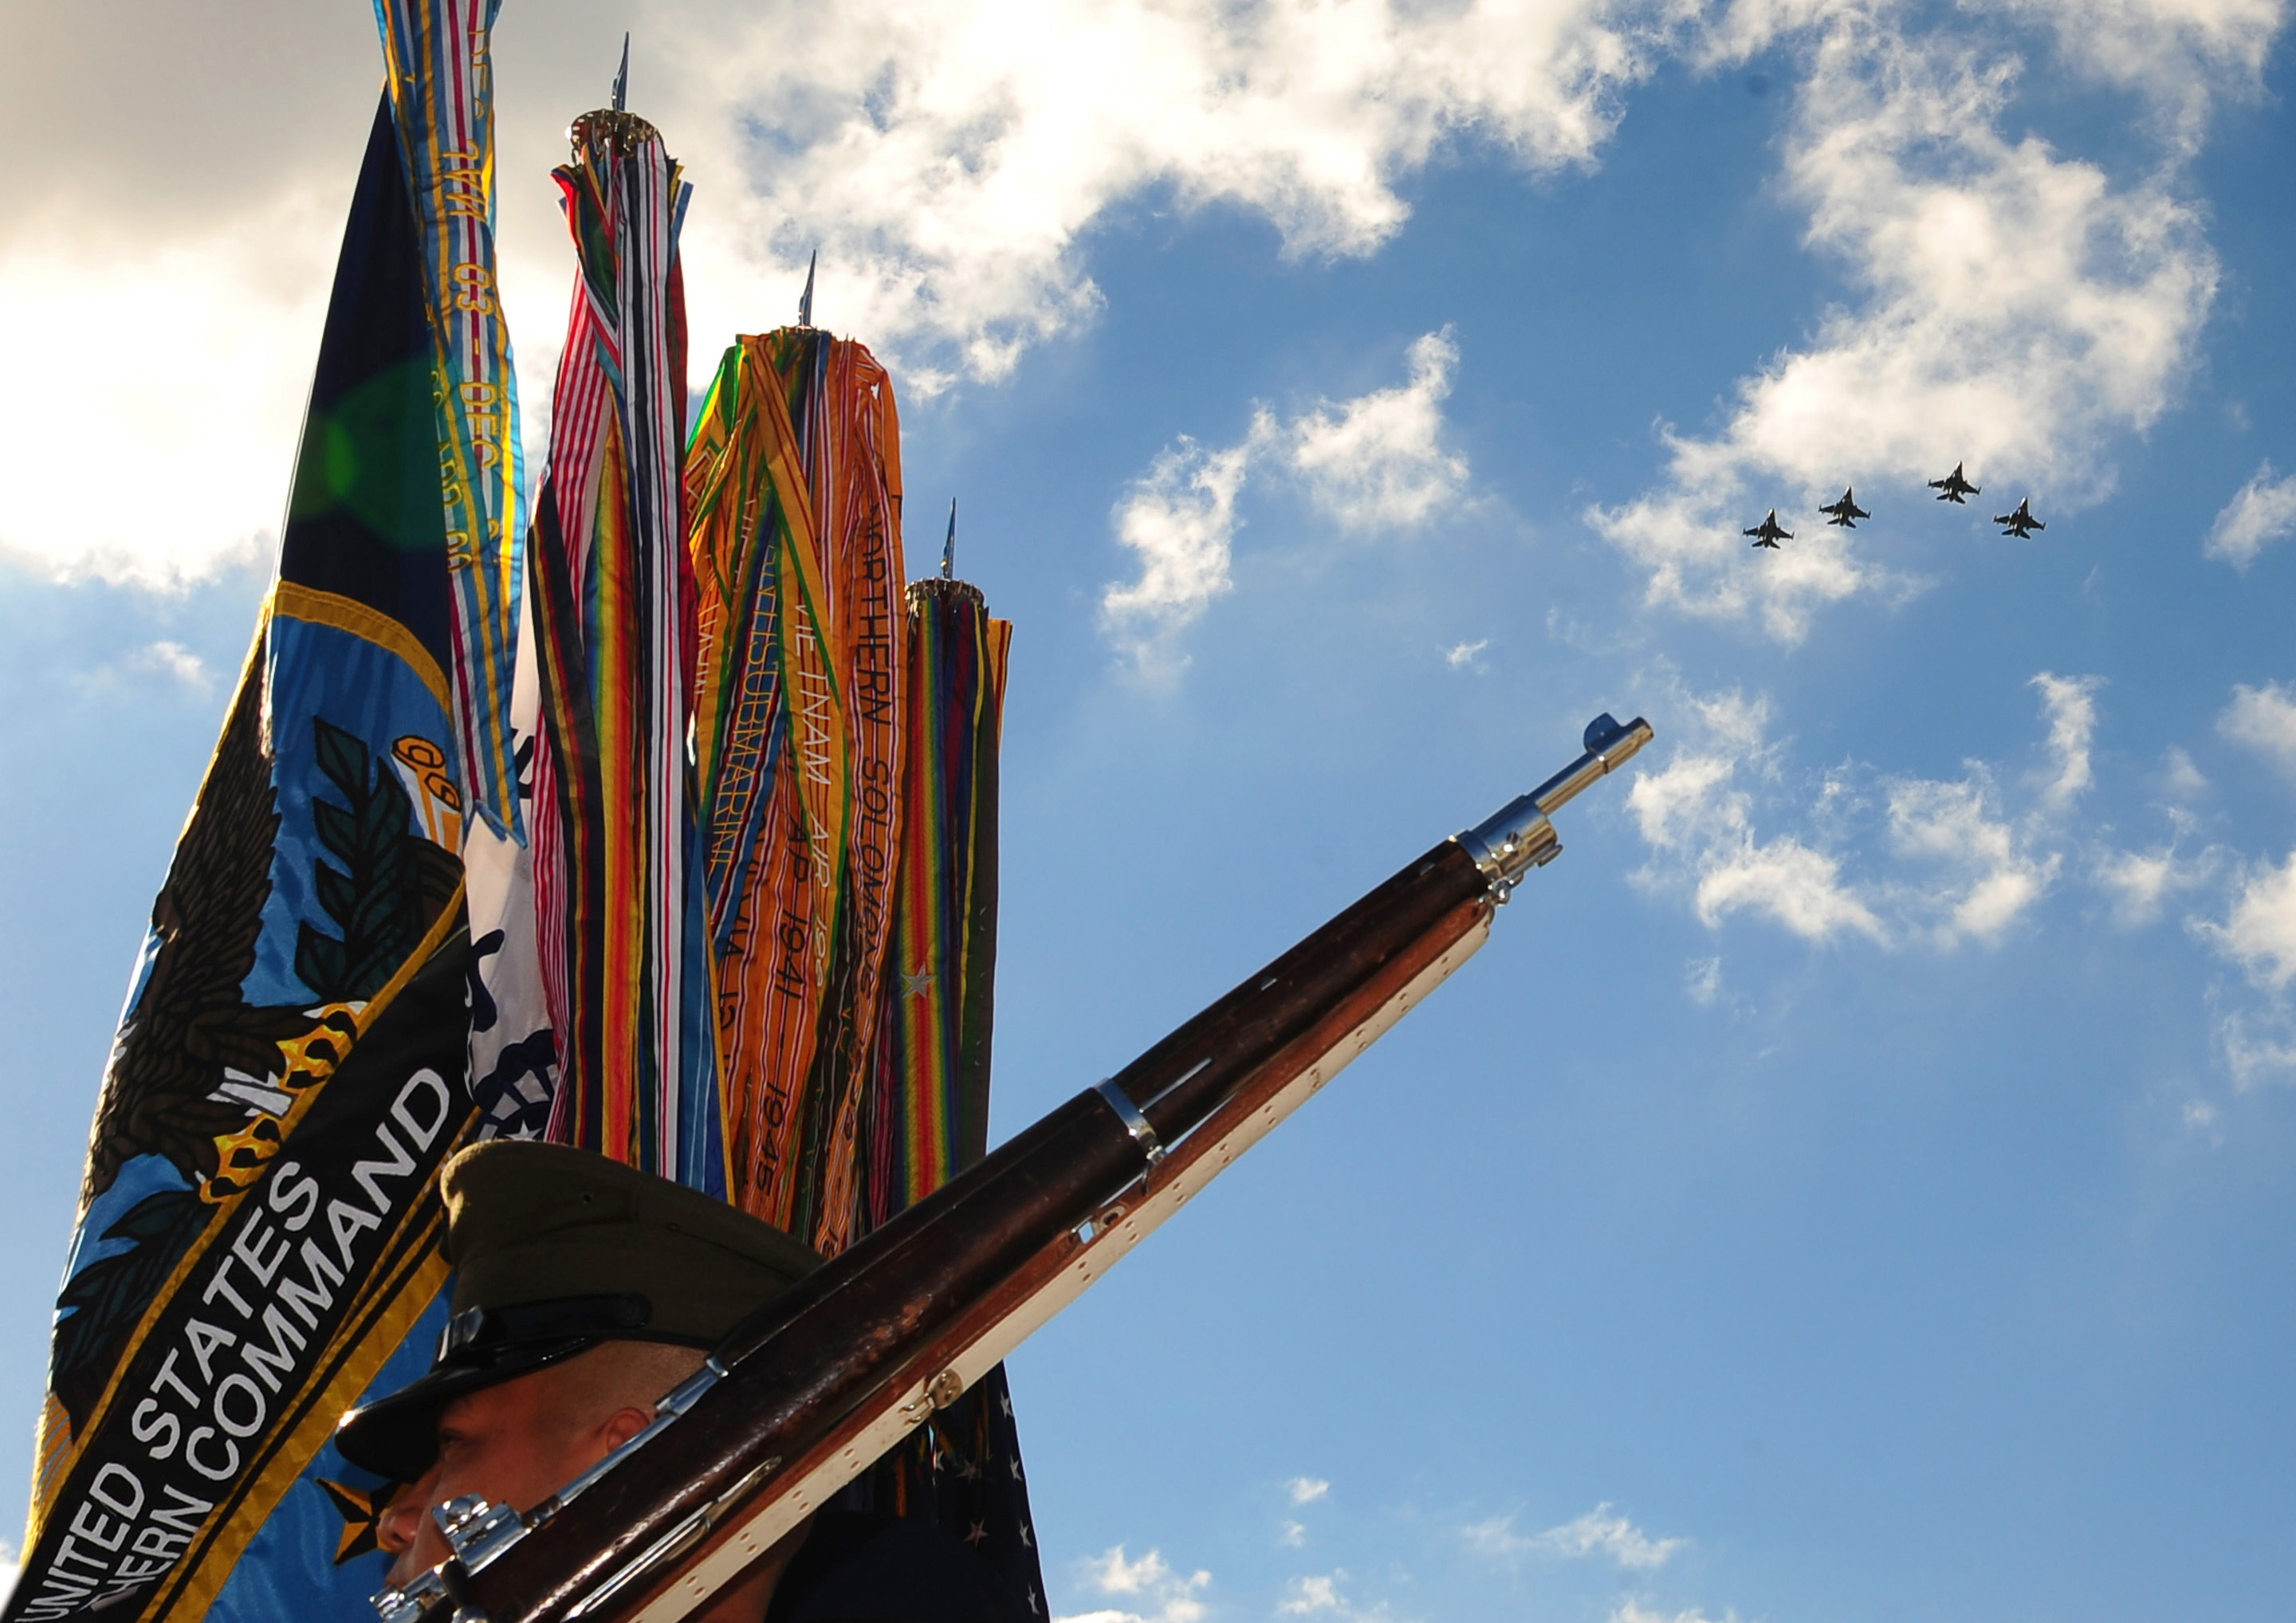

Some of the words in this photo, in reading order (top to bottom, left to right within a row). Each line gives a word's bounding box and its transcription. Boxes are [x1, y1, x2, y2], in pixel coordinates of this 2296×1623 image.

[857, 502, 891, 726] NORTHERN
[775, 909, 808, 1000] 1941
[809, 809, 830, 888] AIR
[859, 756, 890, 993] SOLOMONS
[758, 1081, 788, 1193] 1945
[14, 1462, 145, 1623] UNITED
[132, 1161, 320, 1460] STATES
[77, 1483, 214, 1613] HERN
[185, 1067, 450, 1481] COMMAND
